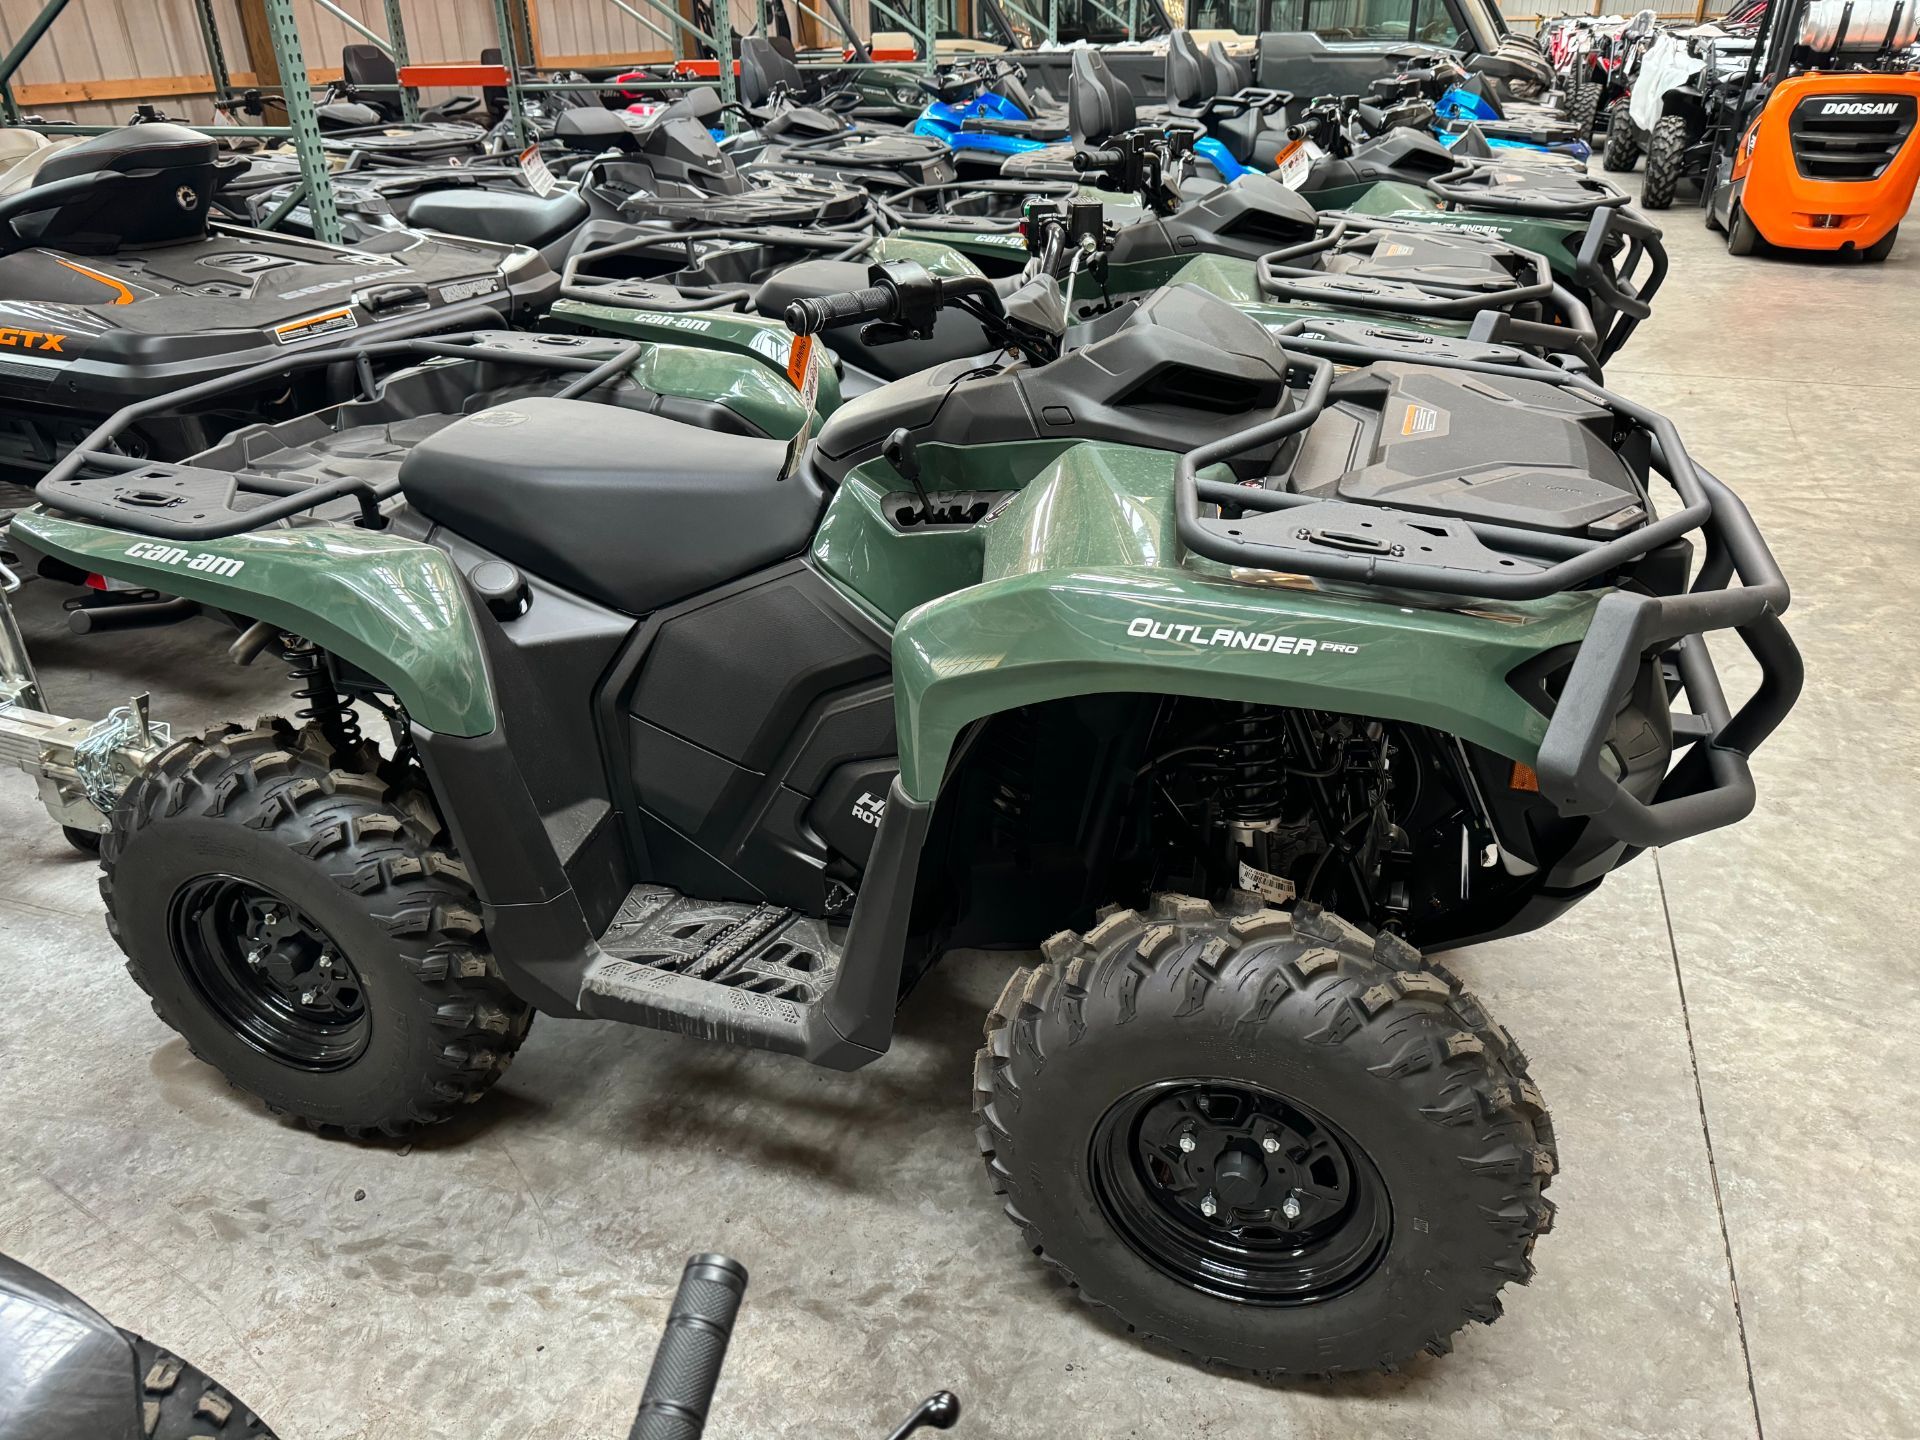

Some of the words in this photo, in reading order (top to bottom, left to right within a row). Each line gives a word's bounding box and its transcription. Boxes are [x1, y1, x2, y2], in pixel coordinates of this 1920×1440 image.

[1821, 103, 1899, 114] DOOSAN
[634, 313, 712, 331] can-am
[0, 328, 67, 352] GTX
[124, 542, 245, 578] can-am
[1127, 617, 1317, 656] OUTLANDER
[1320, 641, 1359, 654] PRO
[852, 804, 882, 828] ROT
